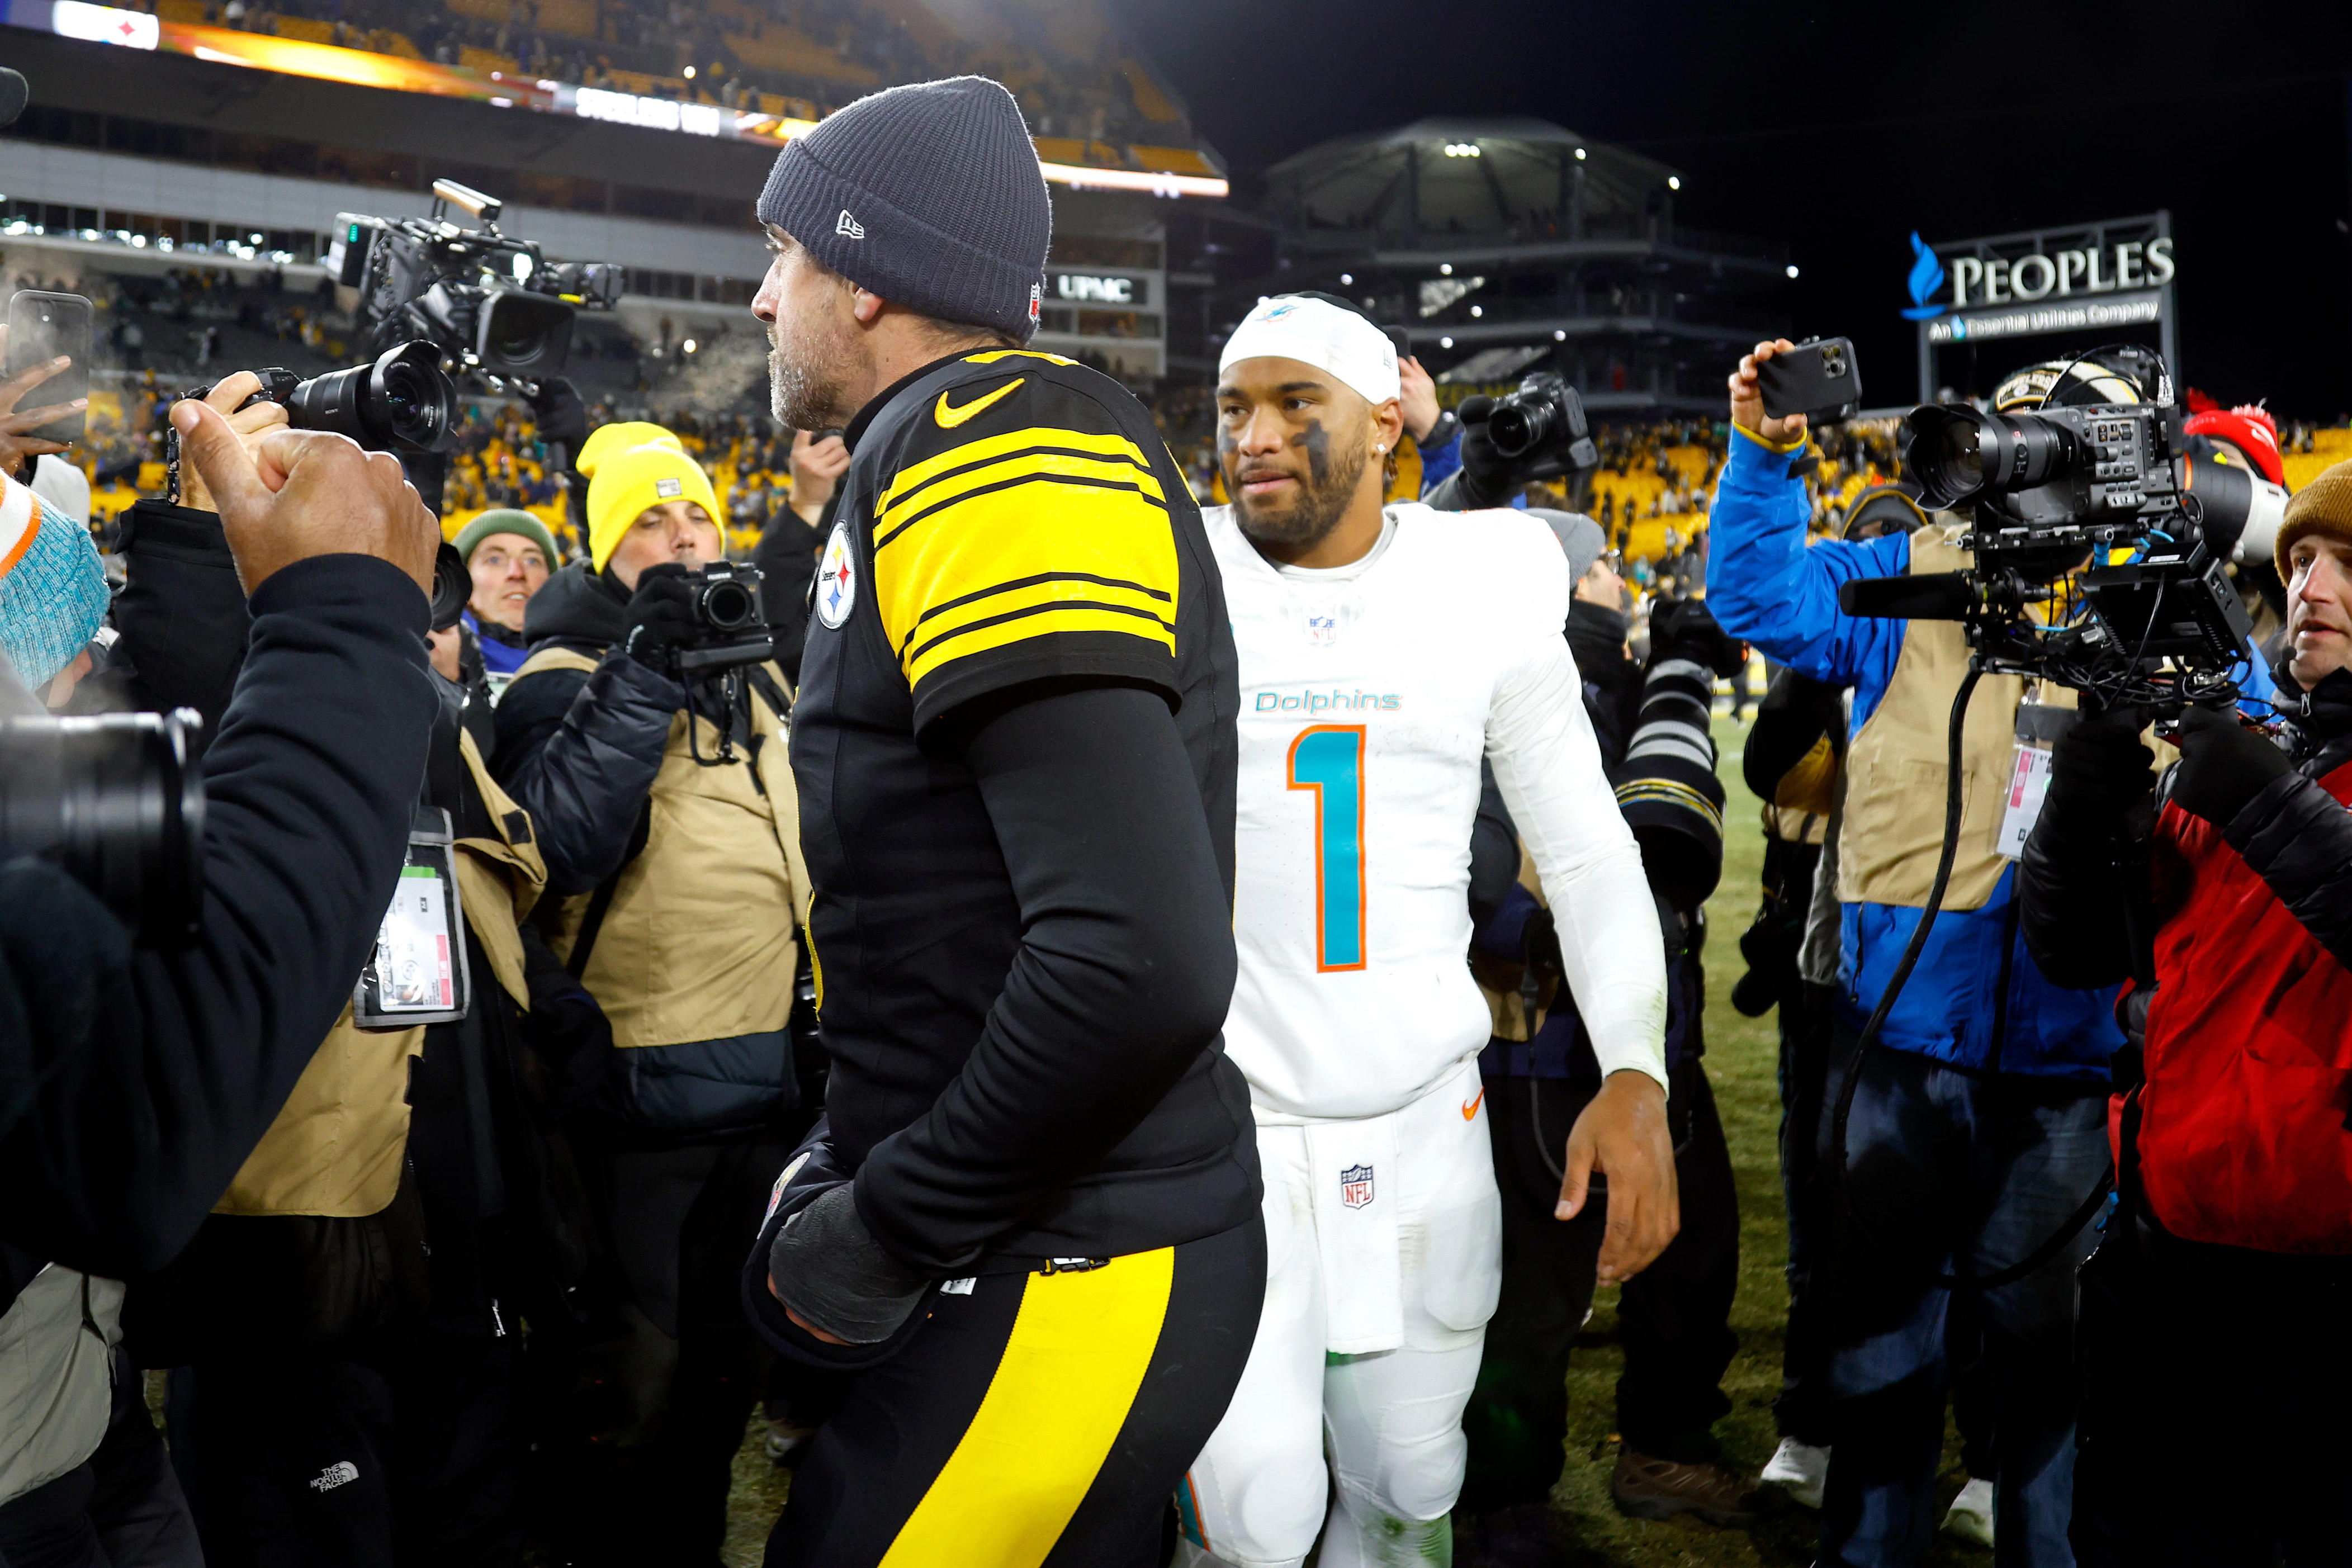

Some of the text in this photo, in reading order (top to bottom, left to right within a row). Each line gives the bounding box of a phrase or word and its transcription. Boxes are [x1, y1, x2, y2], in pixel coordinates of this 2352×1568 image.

[1952, 237, 2175, 307] PEOPLES
[1058, 274, 1132, 303] UPMC
[1929, 322, 1952, 340] An
[2086, 301, 2159, 325] Company
[1313, 628, 1333, 641] NFL
[1255, 689, 1402, 716] Dolphins
[1286, 724, 1367, 973] 1
[1345, 1182, 1370, 1204] NFL
[310, 1473, 343, 1488] NORTH
[321, 1463, 340, 1476] THE
[320, 1478, 344, 1493] FACE
